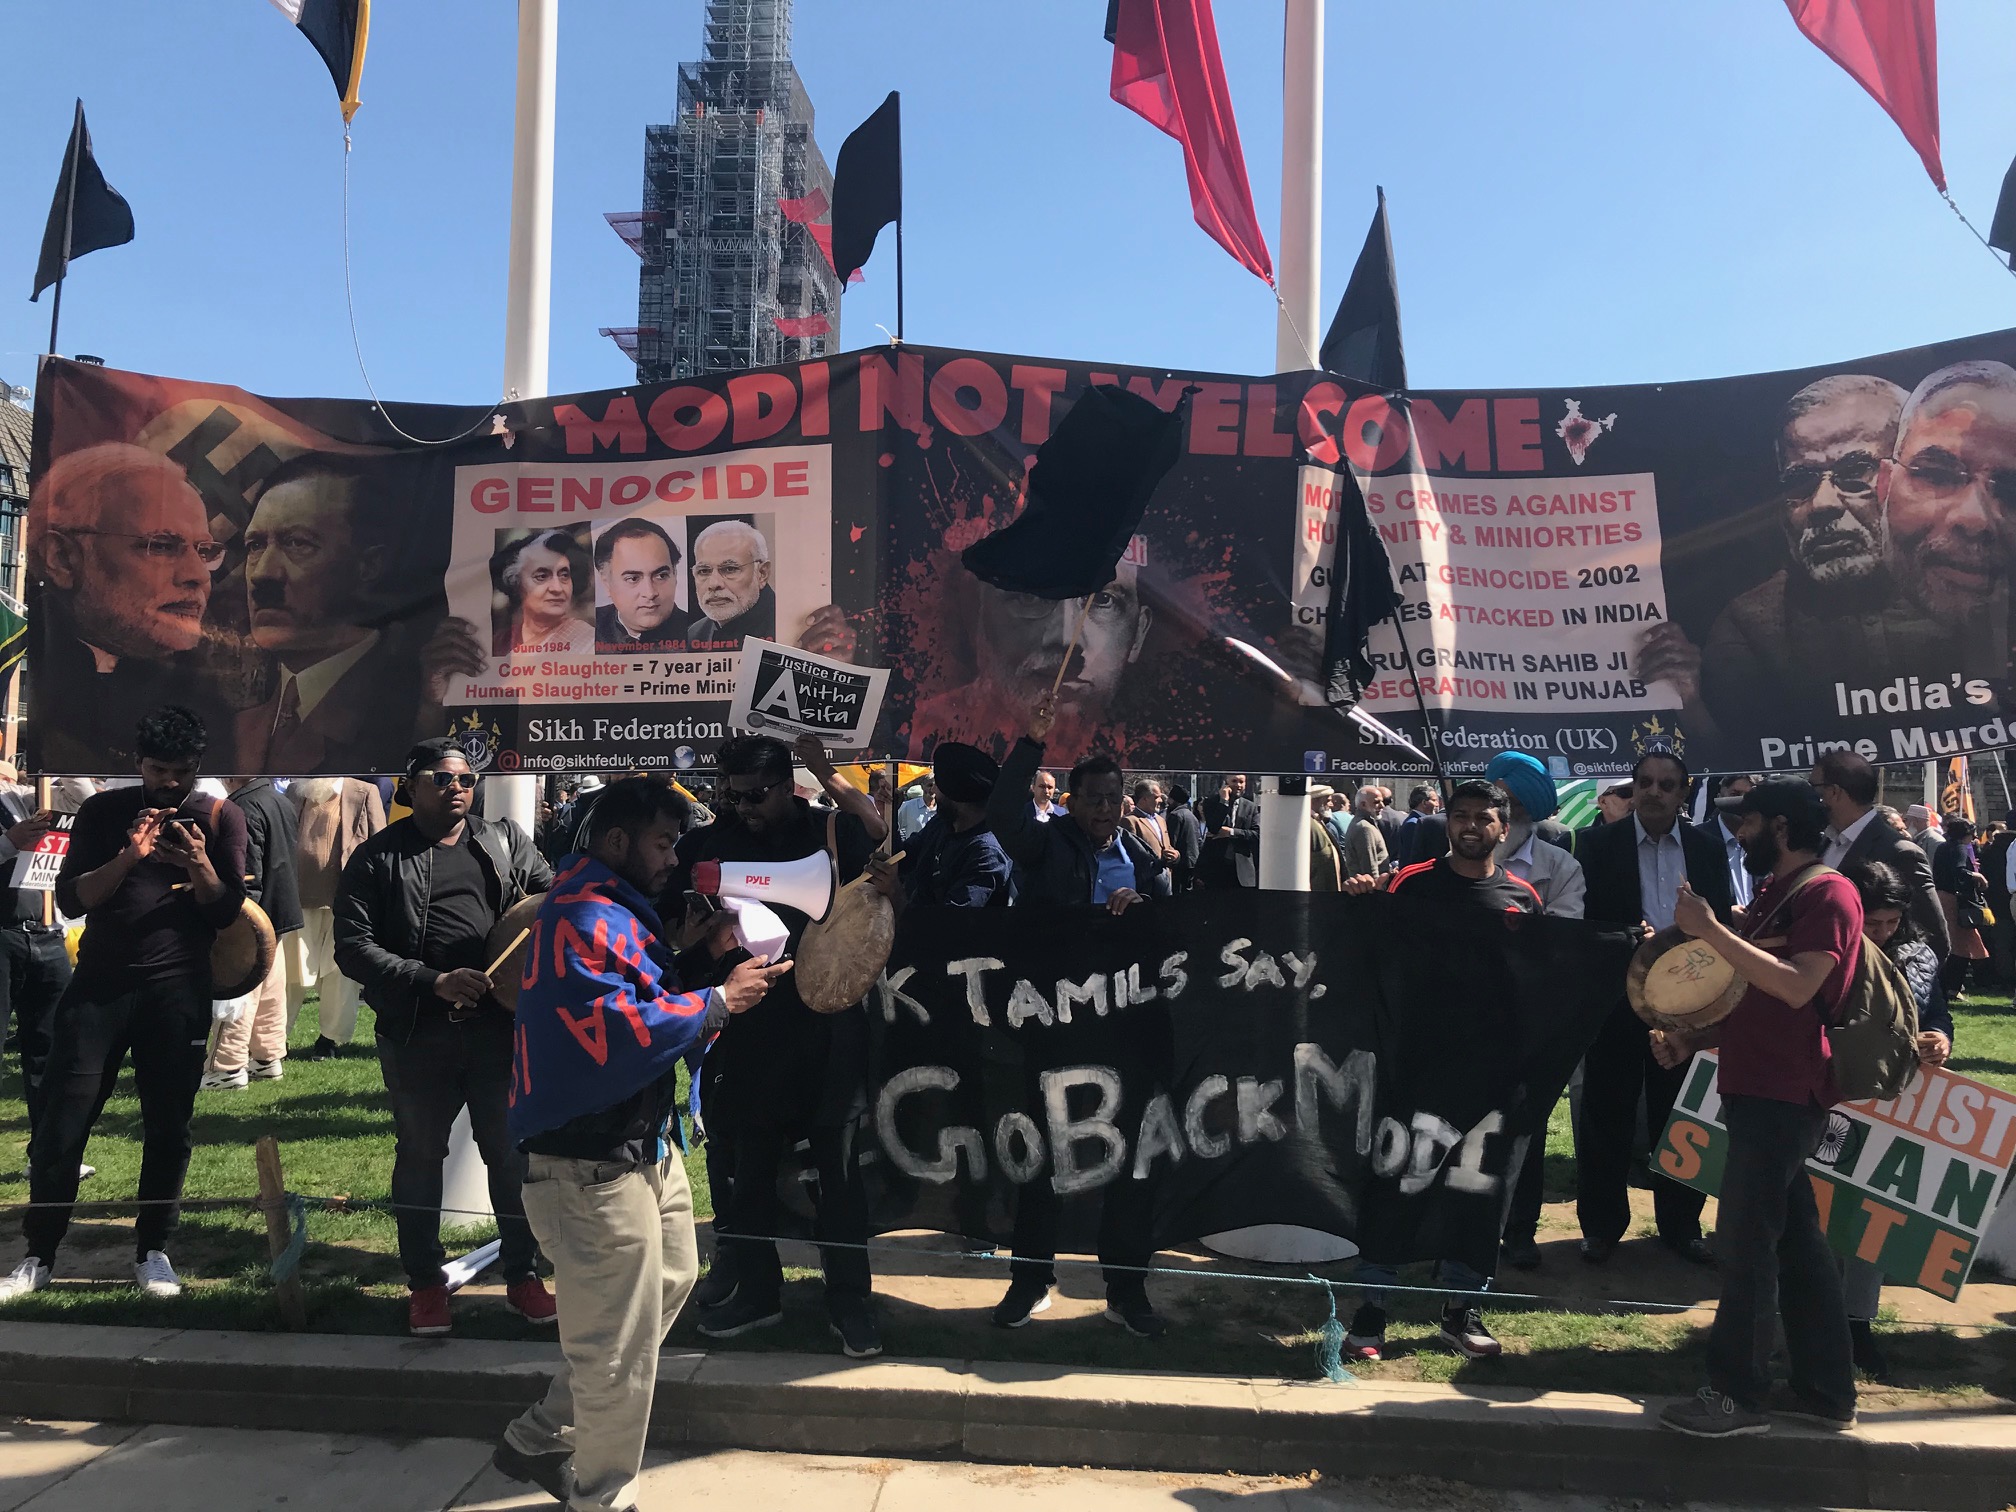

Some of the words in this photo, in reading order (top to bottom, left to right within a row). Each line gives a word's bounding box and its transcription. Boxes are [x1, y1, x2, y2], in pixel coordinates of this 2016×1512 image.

[553, 361, 831, 455] MODI
[859, 353, 1068, 446] NOT
[470, 461, 809, 514] GENOCIDE
[1305, 484, 1386, 514] MOS
[1396, 490, 1497, 515] CRIMES
[1506, 490, 1636, 516] AGAINST
[1308, 518, 1440, 545] HUNITY
[1450, 524, 1467, 545] &
[1475, 522, 1642, 548] MINIORTIES
[1311, 562, 1430, 588] GUAT
[1439, 565, 1569, 589] GENOCIDE
[1577, 564, 1640, 588] 2002
[1298, 601, 1432, 625] CHES
[1439, 603, 1554, 627] ATTACKED
[1562, 607, 1587, 625] IN
[1595, 602, 1662, 623] INDIA
[595, 640, 655, 651] November
[691, 638, 738, 651] Gujarat
[498, 663, 535, 678] Cow
[541, 661, 627, 680] Slaughter
[649, 660, 658, 674] 7
[665, 661, 701, 678] year
[705, 658, 733, 676] jail
[778, 654, 829, 678] Justice
[833, 670, 854, 684] for
[1369, 652, 1408, 671] RU
[1416, 648, 1515, 671] GRANTH
[1522, 653, 1599, 672] SAHIB
[1607, 652, 1628, 671] JI
[465, 683, 526, 699] Human
[532, 682, 618, 700] Slaughter
[640, 681, 690, 695] Prime
[1363, 677, 1506, 699] SECRATION
[1513, 681, 1538, 699] IN
[1544, 680, 1647, 700] PUNJAB
[1835, 673, 1992, 716] India's
[528, 718, 585, 743] Sikh
[593, 716, 723, 741] Federation
[1358, 723, 1412, 745] Sikh
[1421, 726, 1549, 749] Federation
[1555, 728, 1618, 755] (UK)
[523, 753, 669, 771] info@sikhfeduk.com
[1760, 736, 1878, 768] Prime
[1573, 761, 1636, 775] @sikhfed
[745, 875, 771, 886] PYLE
[947, 949, 1188, 1028] TAMILS
